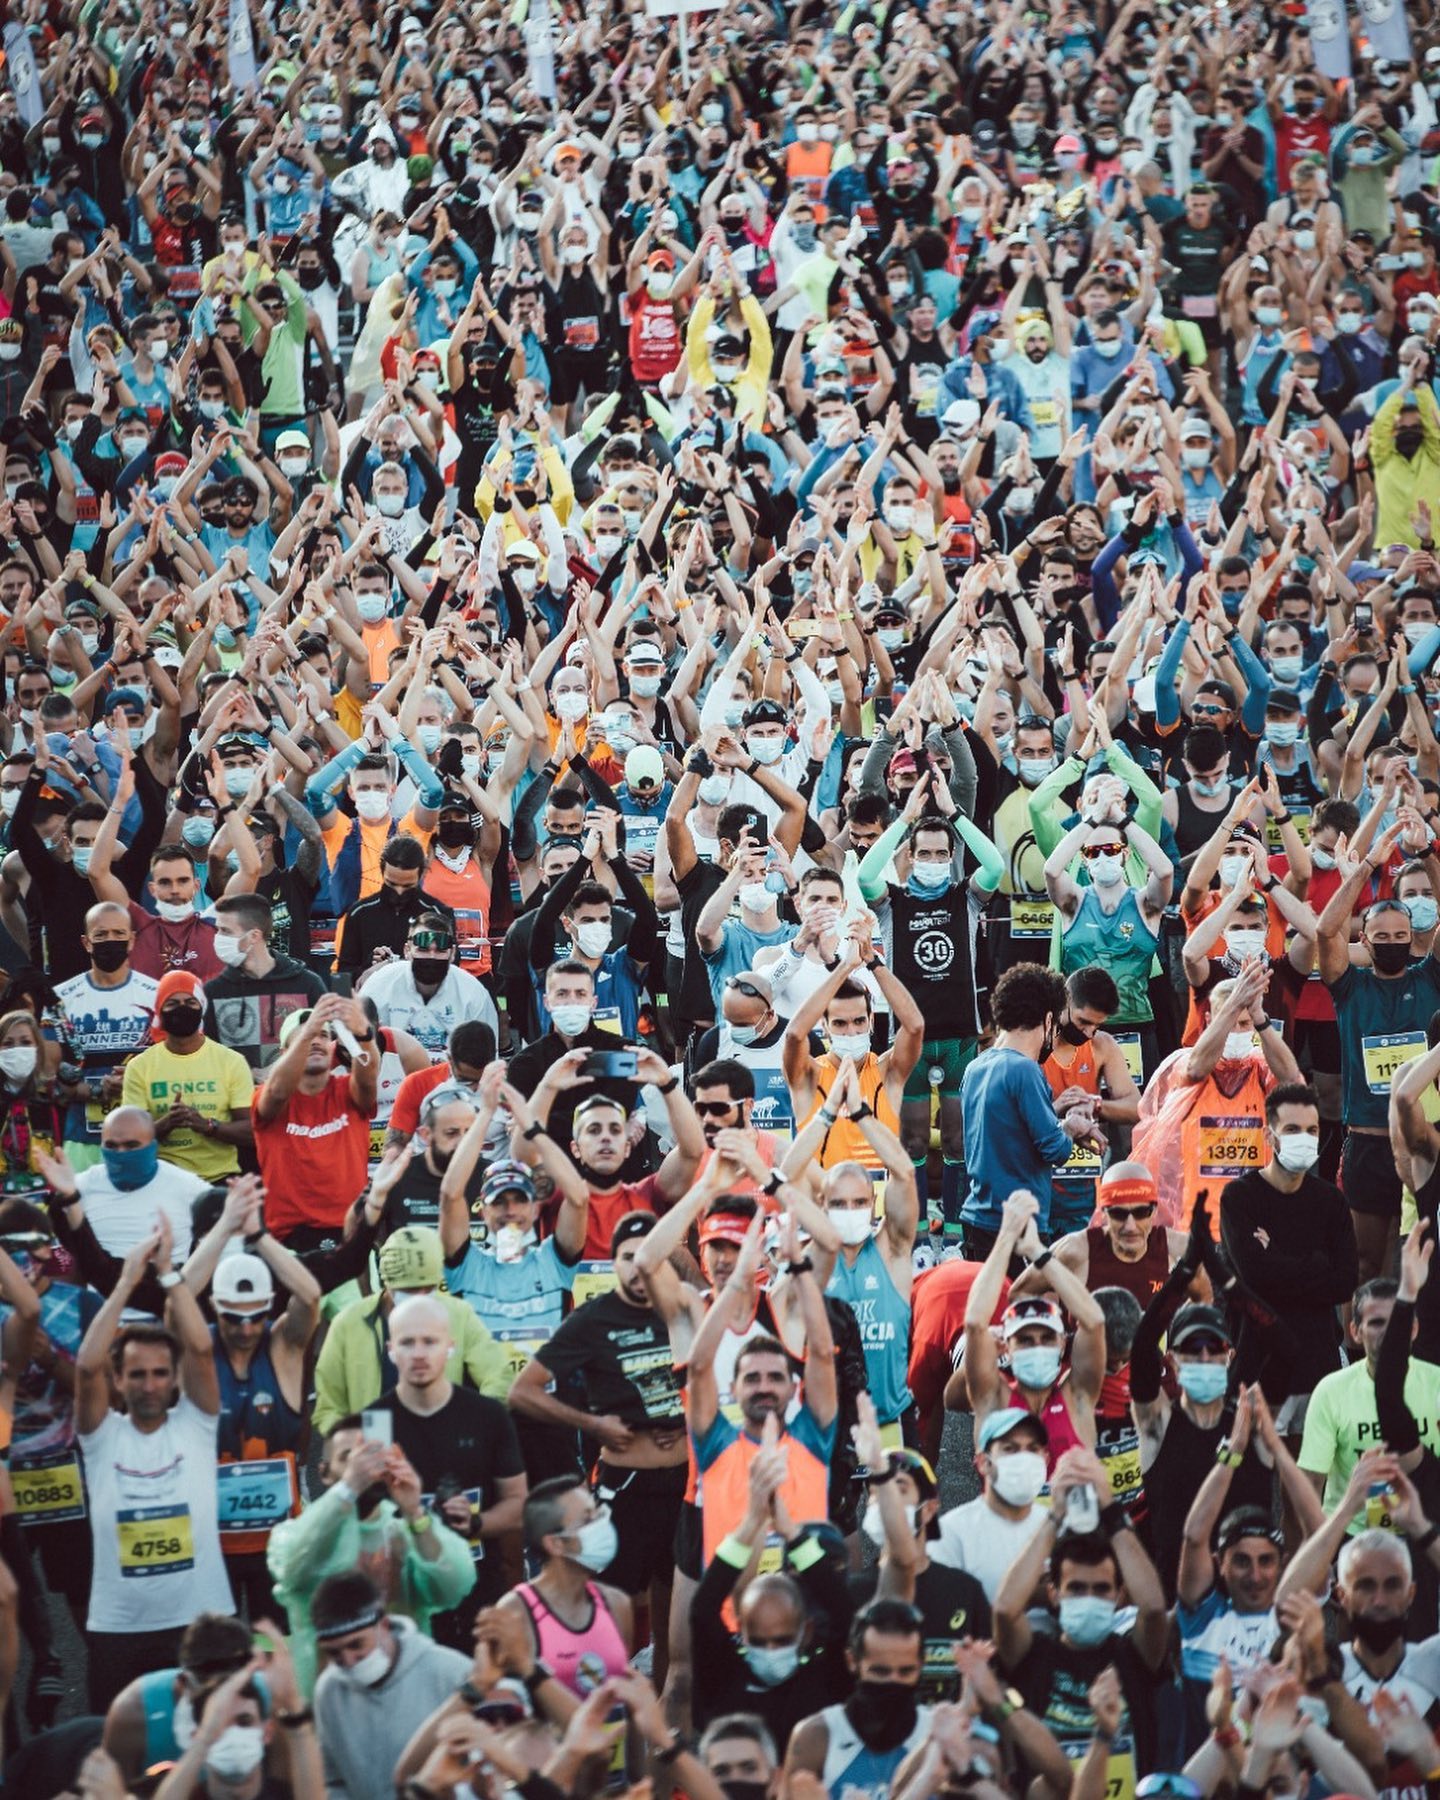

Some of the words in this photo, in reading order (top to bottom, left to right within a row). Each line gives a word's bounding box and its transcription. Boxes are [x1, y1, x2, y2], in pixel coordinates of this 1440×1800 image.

[920, 940, 948, 962] 30
[79, 1032, 140, 1045] UNNERS
[171, 1081, 216, 1094] ONCE
[1207, 1145, 1259, 1160] 13878
[14, 1483, 74, 1506] 10883
[227, 1493, 278, 1513] 7442
[131, 1537, 182, 1558] 4758
